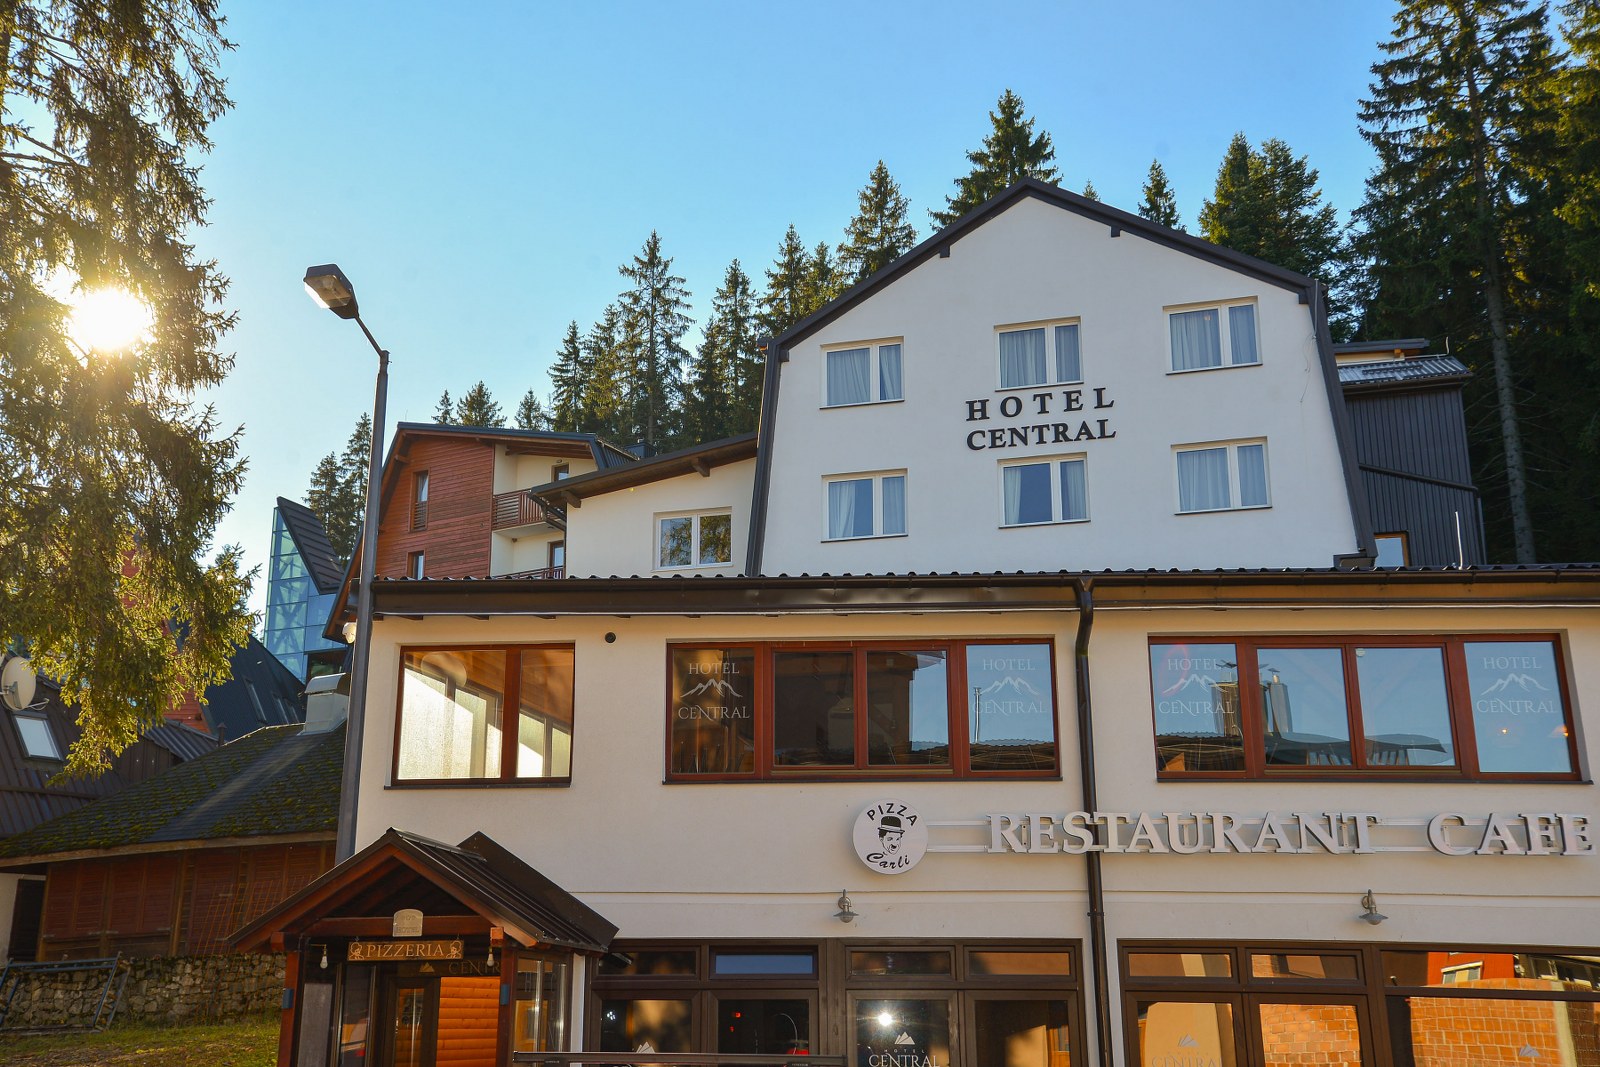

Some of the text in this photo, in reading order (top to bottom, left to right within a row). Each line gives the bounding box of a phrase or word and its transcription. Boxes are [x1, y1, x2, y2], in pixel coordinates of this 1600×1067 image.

[966, 387, 1114, 421] HOTEL
[966, 419, 1116, 450] CENTRAL
[688, 662, 740, 675] HOTEL
[983, 658, 1036, 671] HOTEL
[1168, 658, 1223, 671] HOTEL
[1483, 656, 1541, 670] HOTEL
[678, 704, 750, 722] CENTRAL
[972, 700, 1047, 717] CENTRAL
[1158, 700, 1234, 716] CENTRAL
[1476, 698, 1559, 715] CENTRAL
[866, 803, 918, 826] PIZZA
[985, 811, 1597, 855] RESTAURANT CAFE
[366, 943, 444, 958] PIZZERIA
[868, 1053, 940, 1067] CENTRAL
